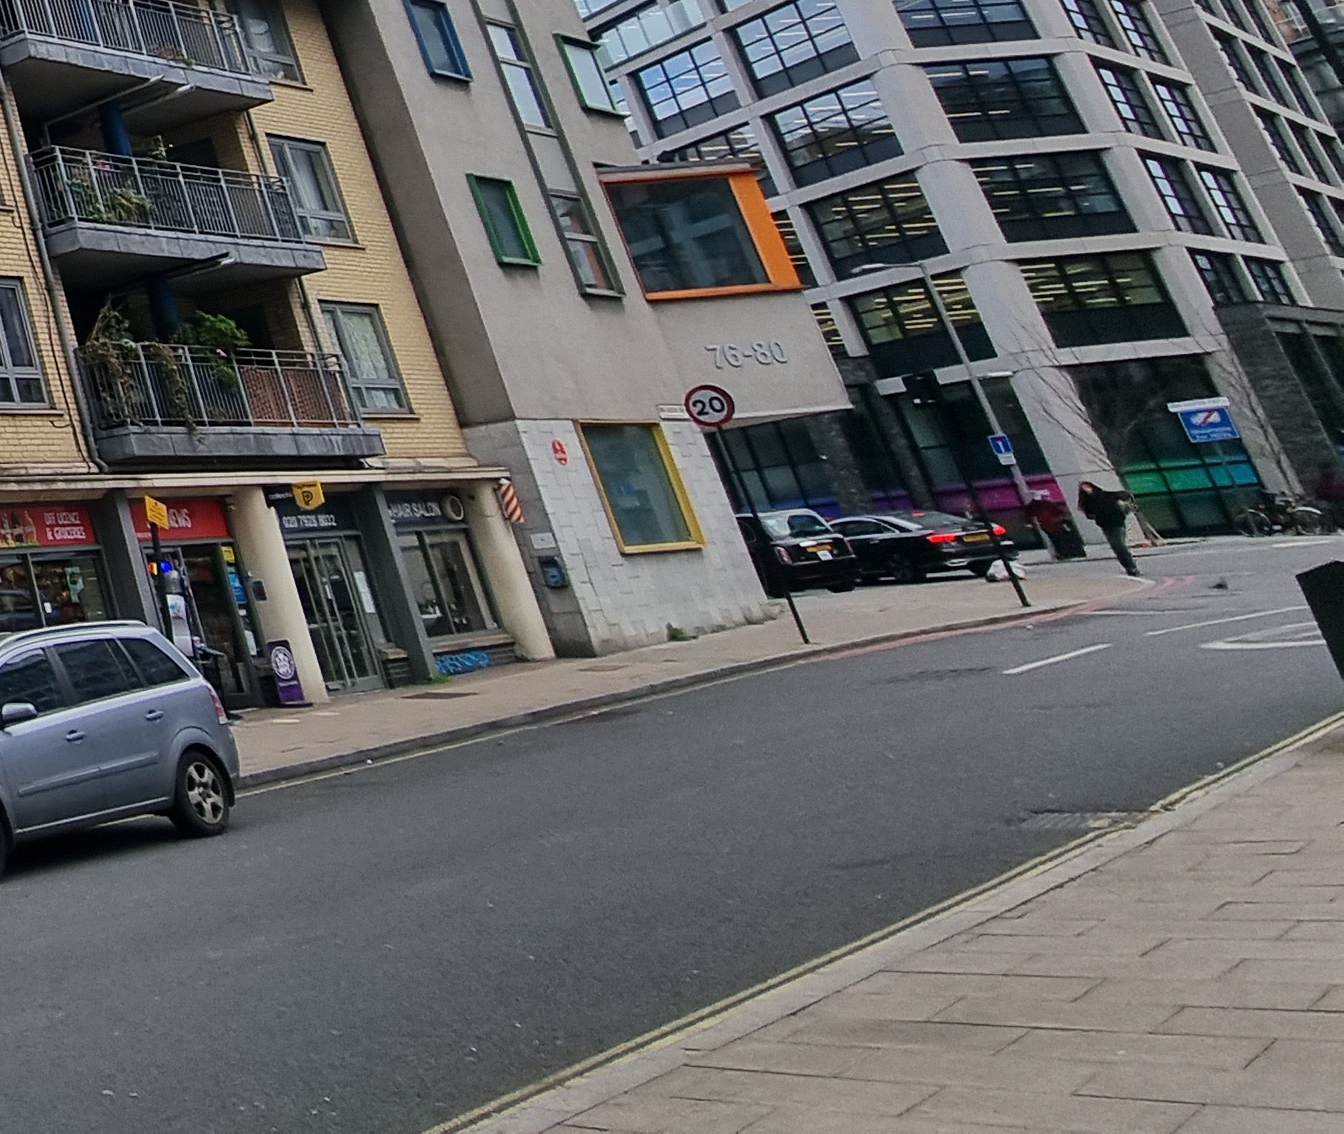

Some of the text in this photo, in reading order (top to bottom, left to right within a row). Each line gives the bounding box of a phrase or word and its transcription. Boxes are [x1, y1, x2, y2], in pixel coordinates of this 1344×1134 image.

[704, 340, 789, 371] 76-80
[691, 396, 726, 416] 20
[167, 508, 192, 528] EWS
